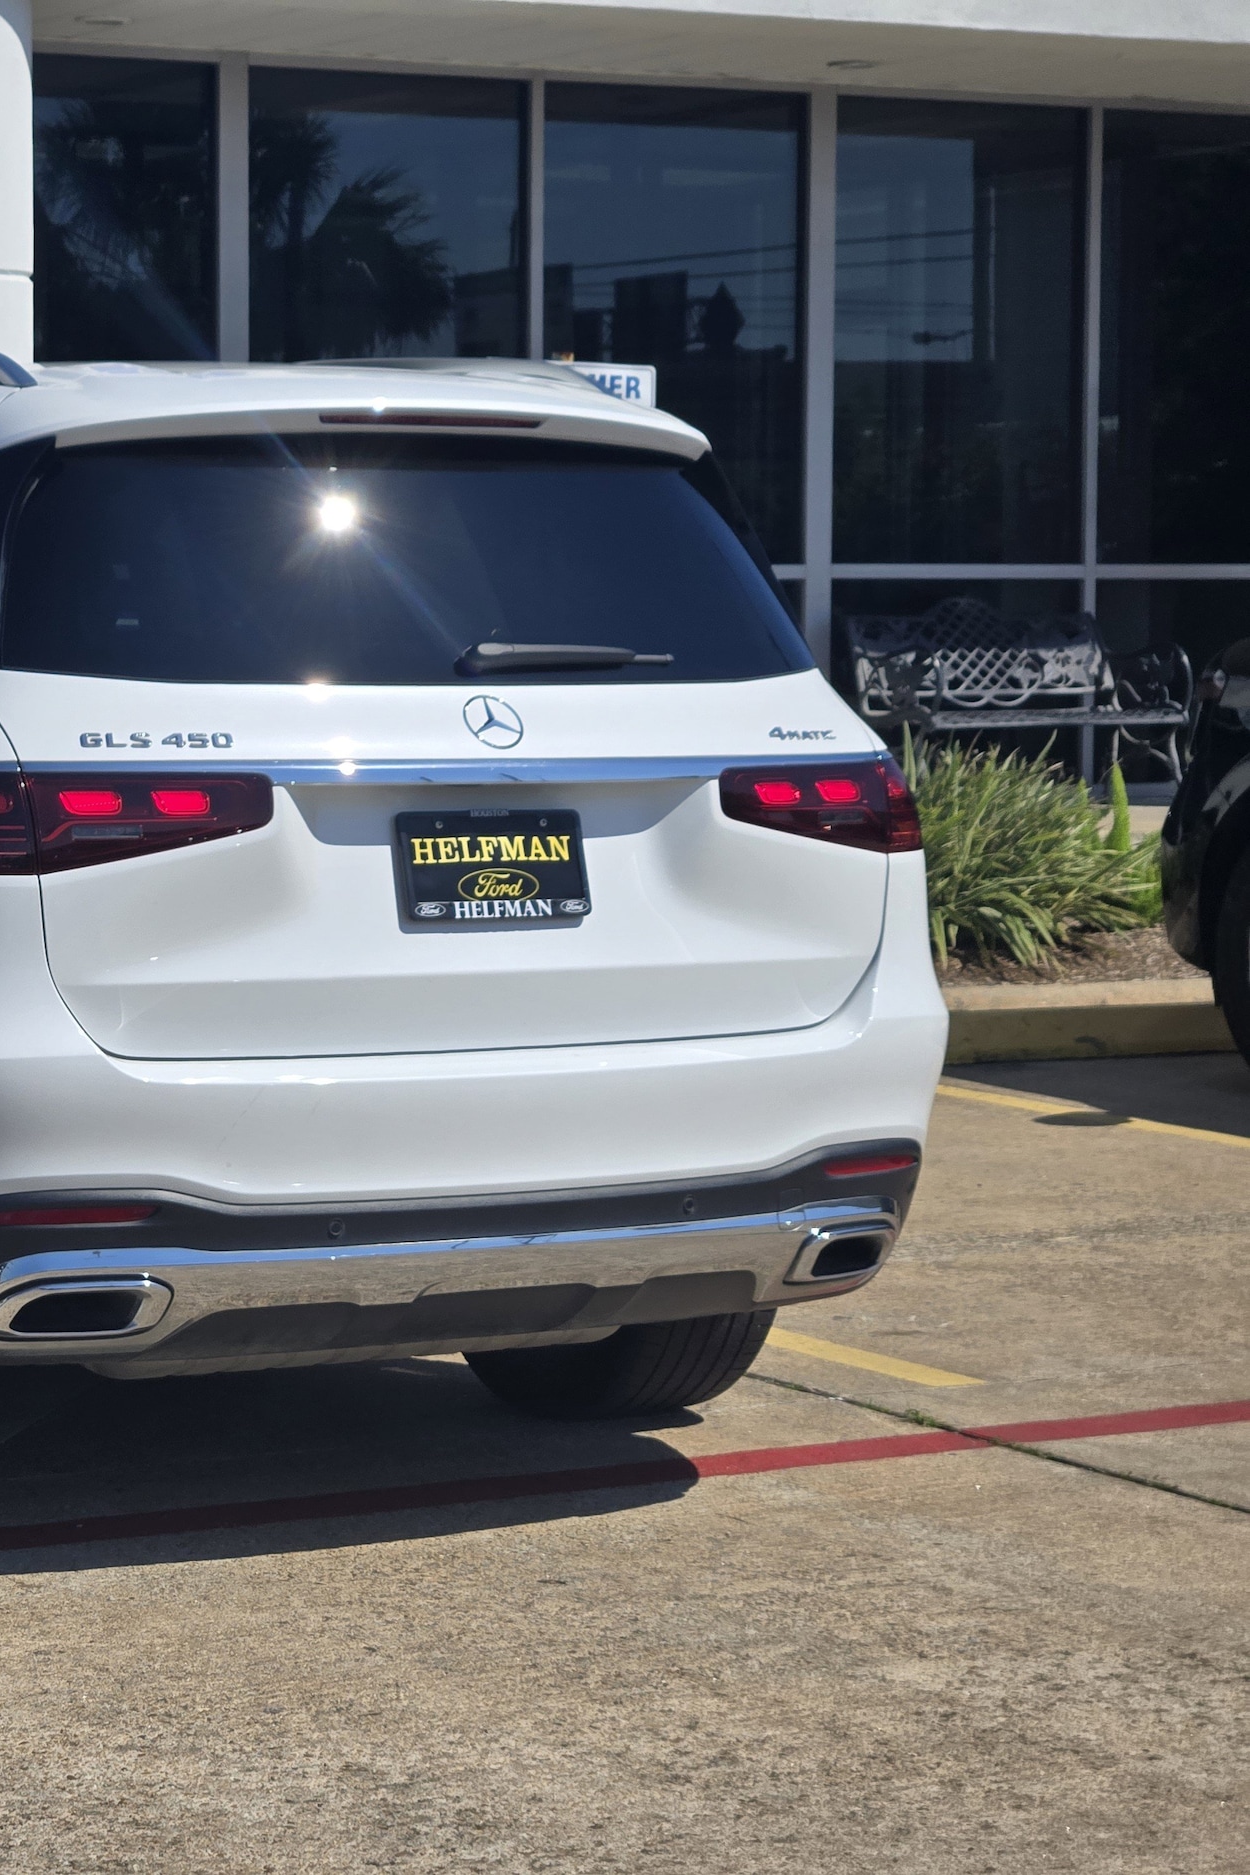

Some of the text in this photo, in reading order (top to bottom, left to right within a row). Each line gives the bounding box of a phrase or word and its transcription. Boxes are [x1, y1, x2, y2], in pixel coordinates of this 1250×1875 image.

[79, 732, 234, 748] GLS 450
[411, 835, 570, 864] HELFMAN
[474, 872, 523, 897] Ford
[453, 899, 552, 919] HELFMAN
